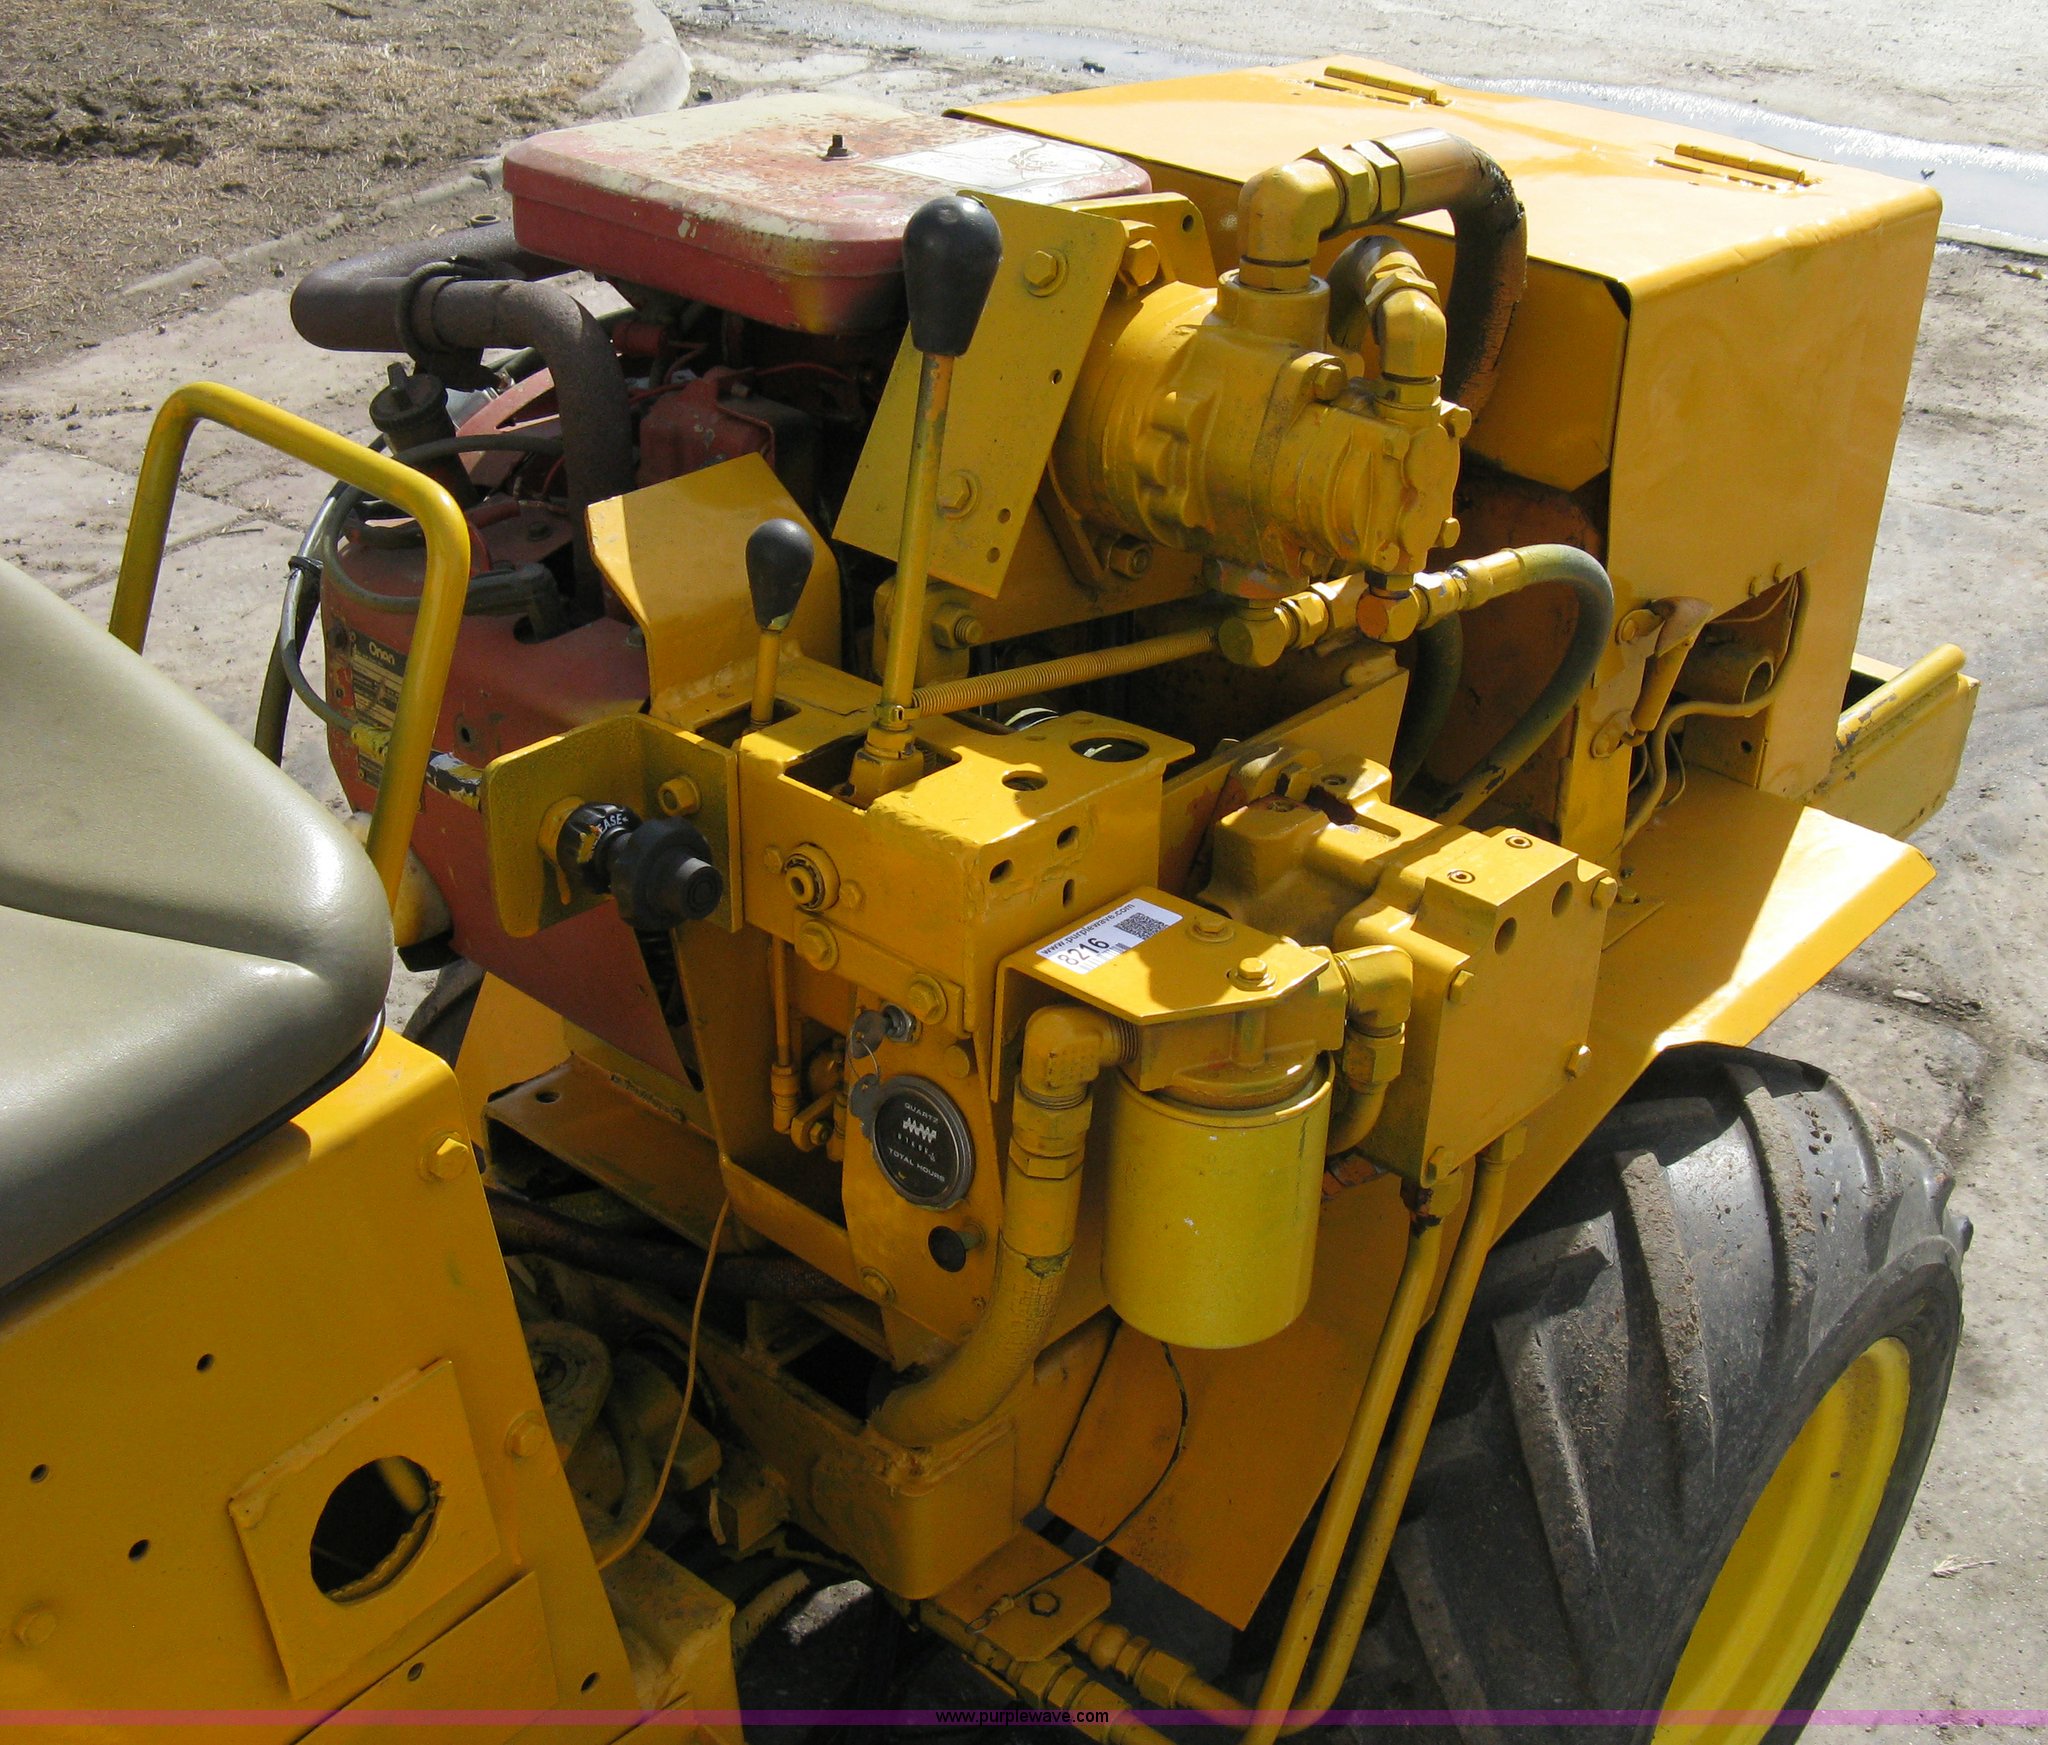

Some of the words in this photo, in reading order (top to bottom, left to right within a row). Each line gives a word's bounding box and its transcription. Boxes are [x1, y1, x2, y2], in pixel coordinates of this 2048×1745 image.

[368, 641, 395, 665] Onan
[1042, 903, 1136, 955] www.purplewave.com
[1058, 937, 1110, 966] 8216
[904, 1102, 938, 1124] QUARTZ
[888, 1148, 914, 1167] TOTAL
[917, 1163, 945, 1183] HOURS
